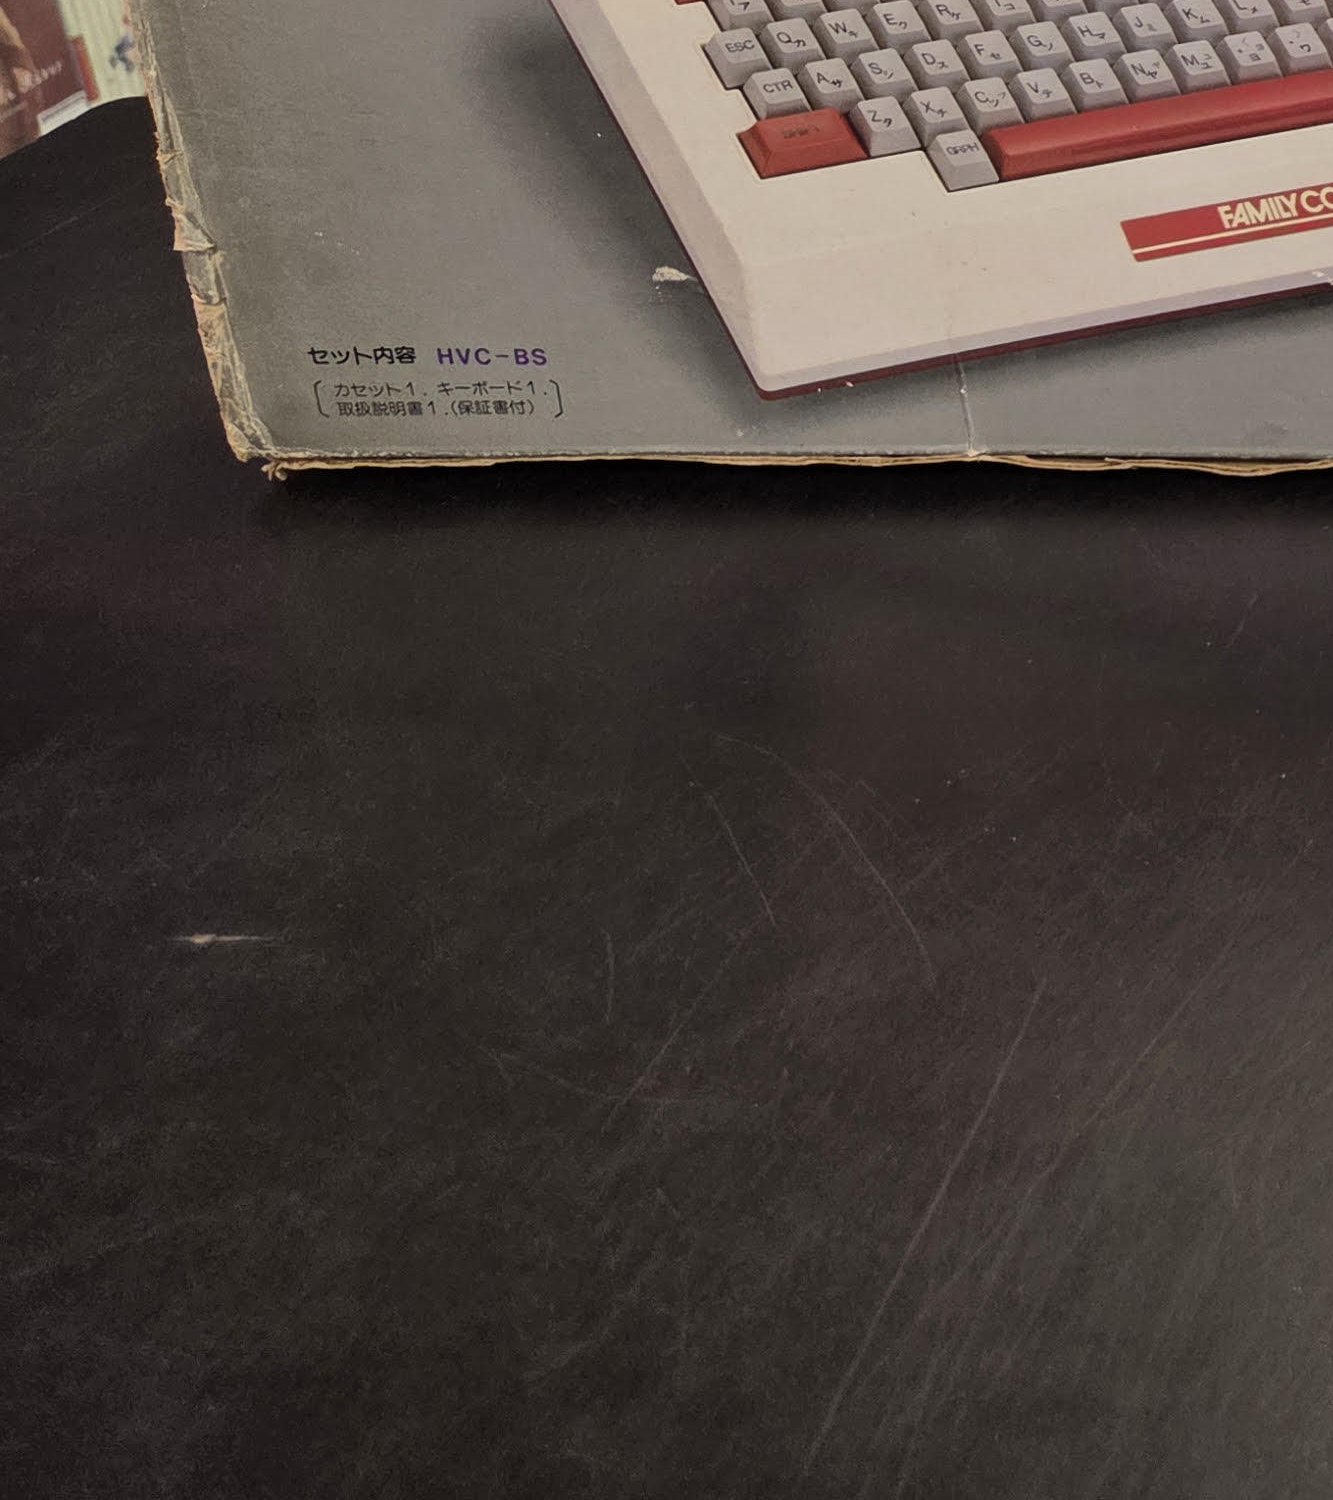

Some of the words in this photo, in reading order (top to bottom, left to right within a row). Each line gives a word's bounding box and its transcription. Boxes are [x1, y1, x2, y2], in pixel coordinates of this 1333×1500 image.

[726, 40, 755, 53] ESC
[762, 80, 794, 94] CTR
[1217, 194, 1297, 229] FAMILY
[308, 346, 417, 365] セット内容
[436, 347, 548, 366] HVC-BS
